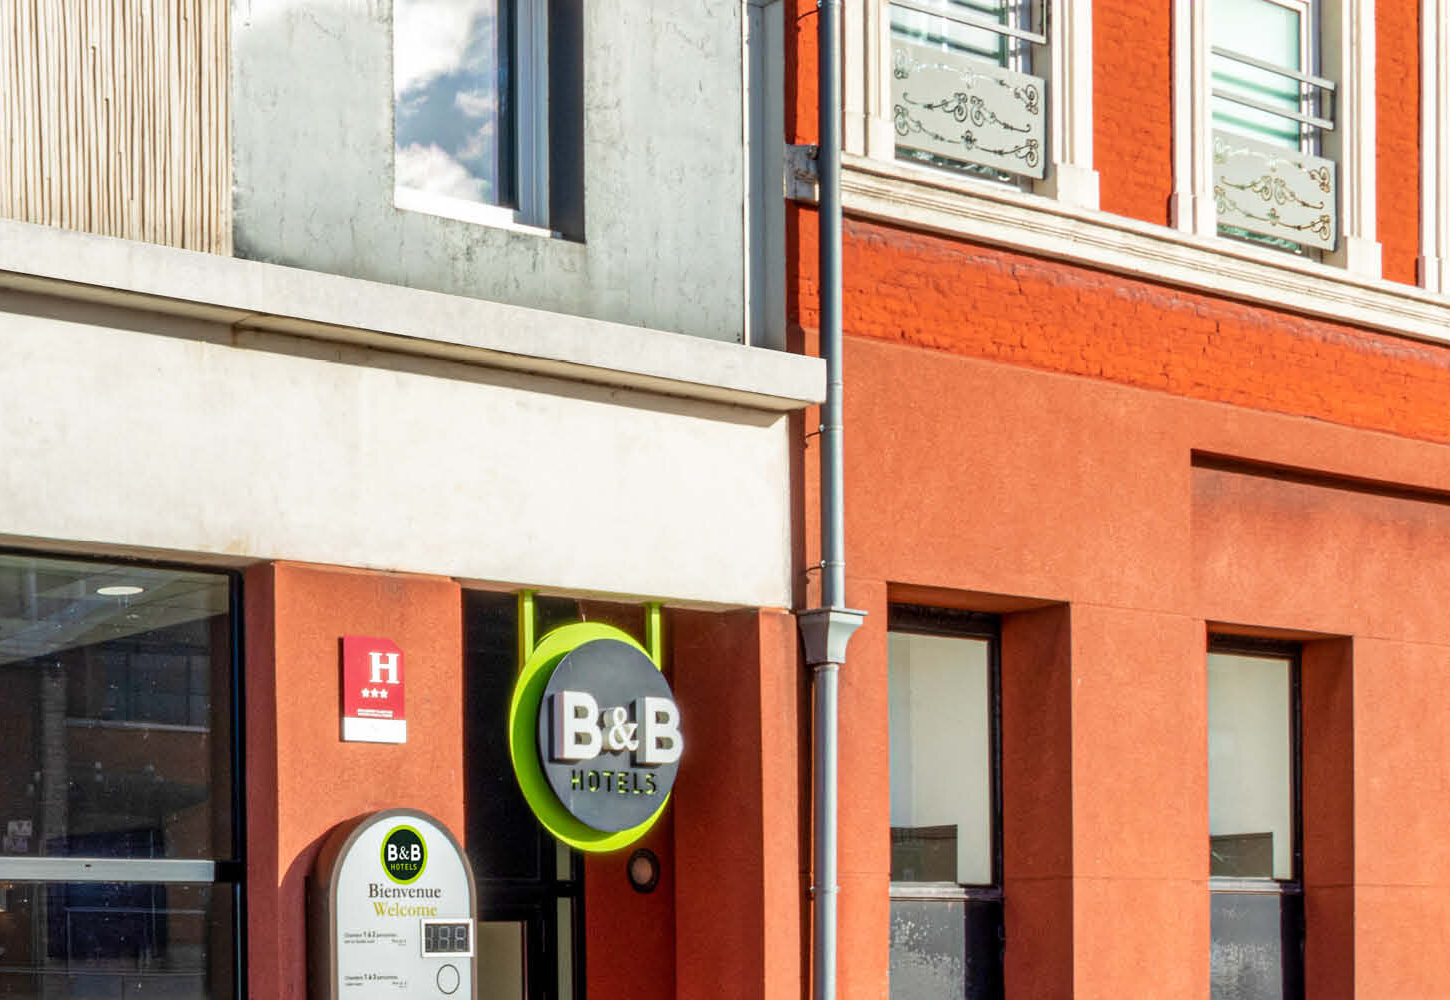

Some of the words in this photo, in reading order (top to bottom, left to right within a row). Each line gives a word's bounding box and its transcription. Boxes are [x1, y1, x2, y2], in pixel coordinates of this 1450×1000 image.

[368, 651, 400, 684] H
[553, 690, 684, 765] B&B
[571, 769, 657, 795] HOTELS
[387, 843, 421, 861] B&B
[390, 863, 418, 871] HOTELS
[368, 883, 442, 898] Bienvenue
[373, 901, 438, 917] Welcome
